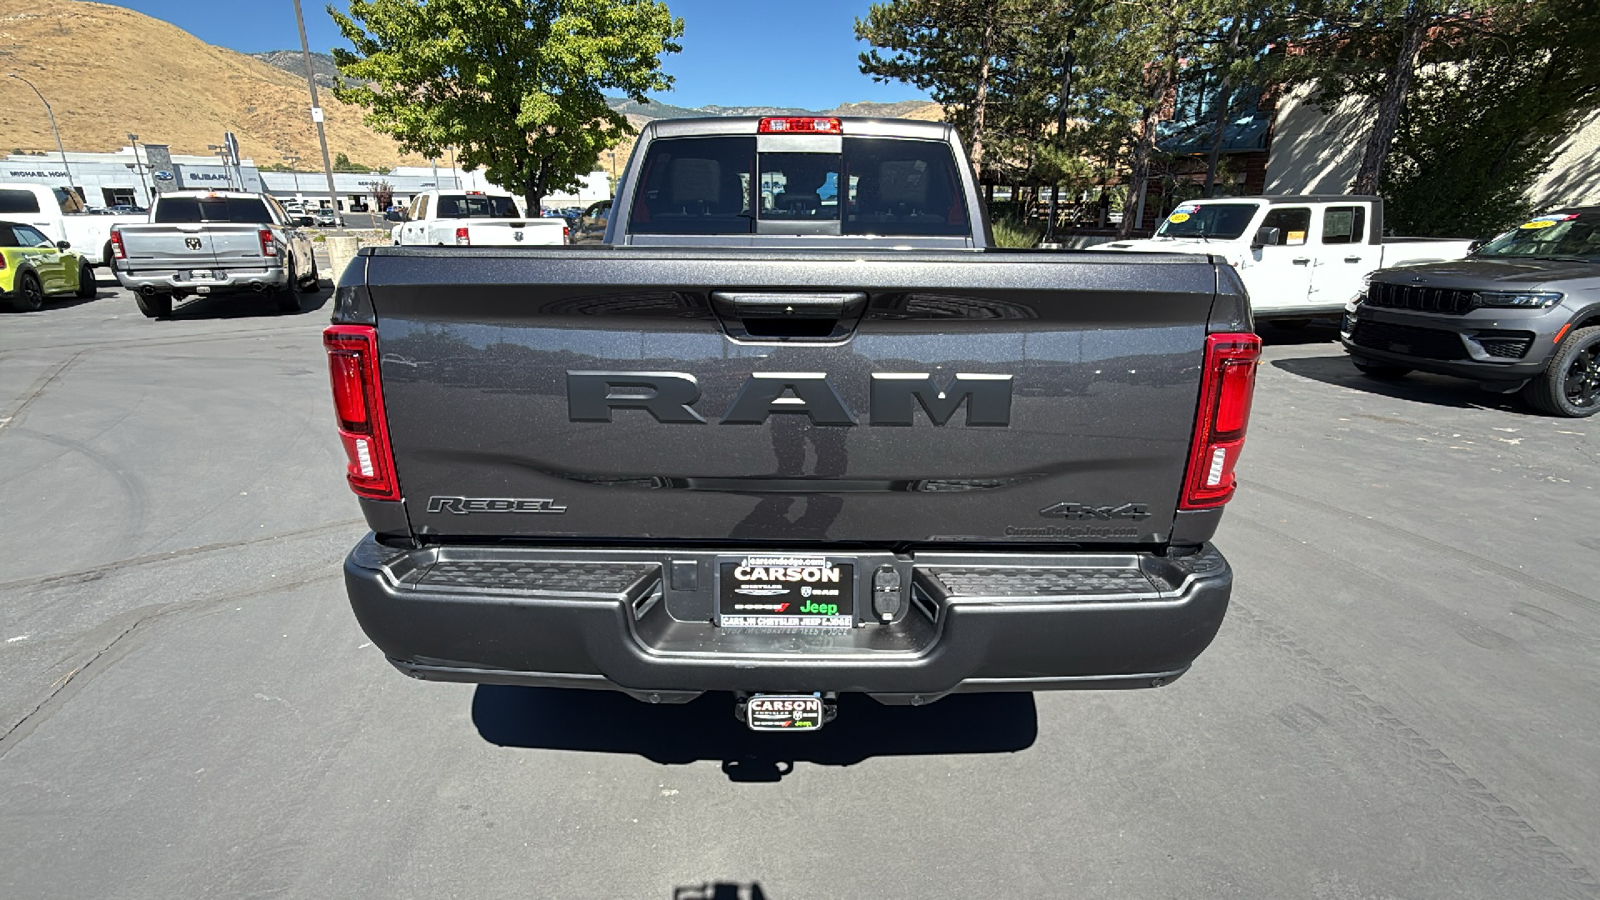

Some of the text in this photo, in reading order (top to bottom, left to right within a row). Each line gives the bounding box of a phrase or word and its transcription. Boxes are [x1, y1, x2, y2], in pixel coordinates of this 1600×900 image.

[566, 370, 1014, 427] RAM
[427, 495, 567, 514] REBEL
[1005, 526, 1138, 538] CarsonDodgeJeep.com
[734, 567, 840, 582] CARSON
[800, 600, 837, 616] Jeep
[752, 701, 818, 711] CARSON
